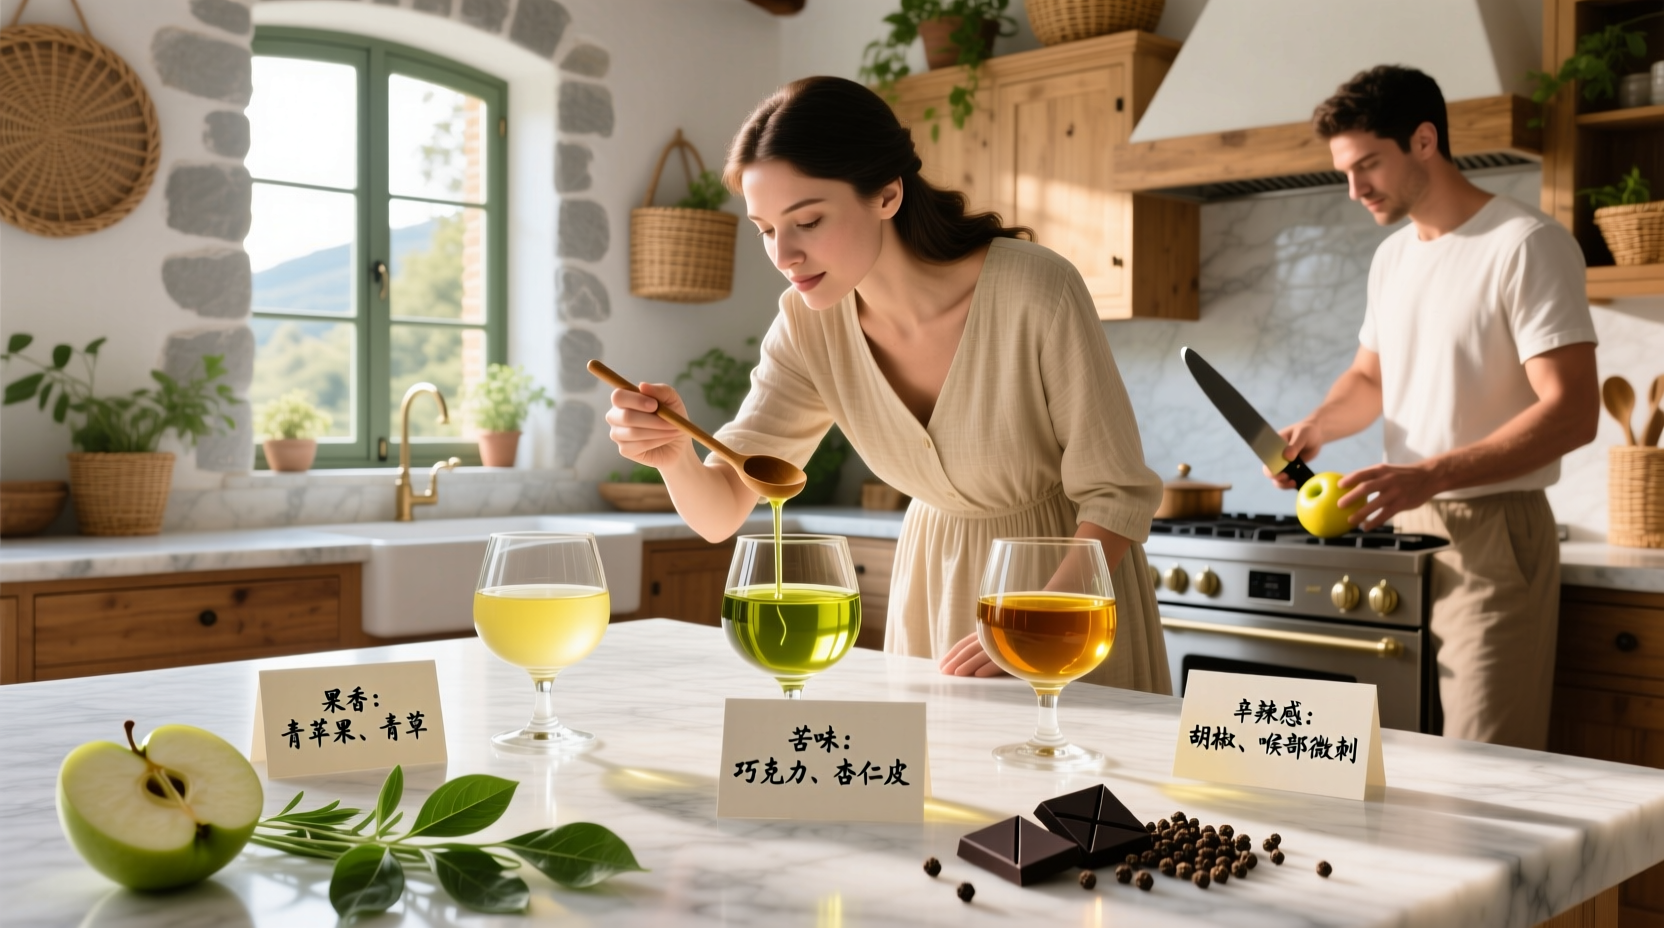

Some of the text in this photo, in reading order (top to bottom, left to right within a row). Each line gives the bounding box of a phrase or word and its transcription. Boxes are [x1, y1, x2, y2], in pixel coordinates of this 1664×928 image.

[321, 686, 379, 714] 果香：
[1233, 698, 1313, 727] 辛辣感：
[281, 710, 428, 750] 青苹果、青草
[788, 724, 850, 753] 苦味：
[1189, 724, 1358, 764] 胡椒、喉部微刺
[733, 756, 910, 786] 巧克力、杏仁皮
